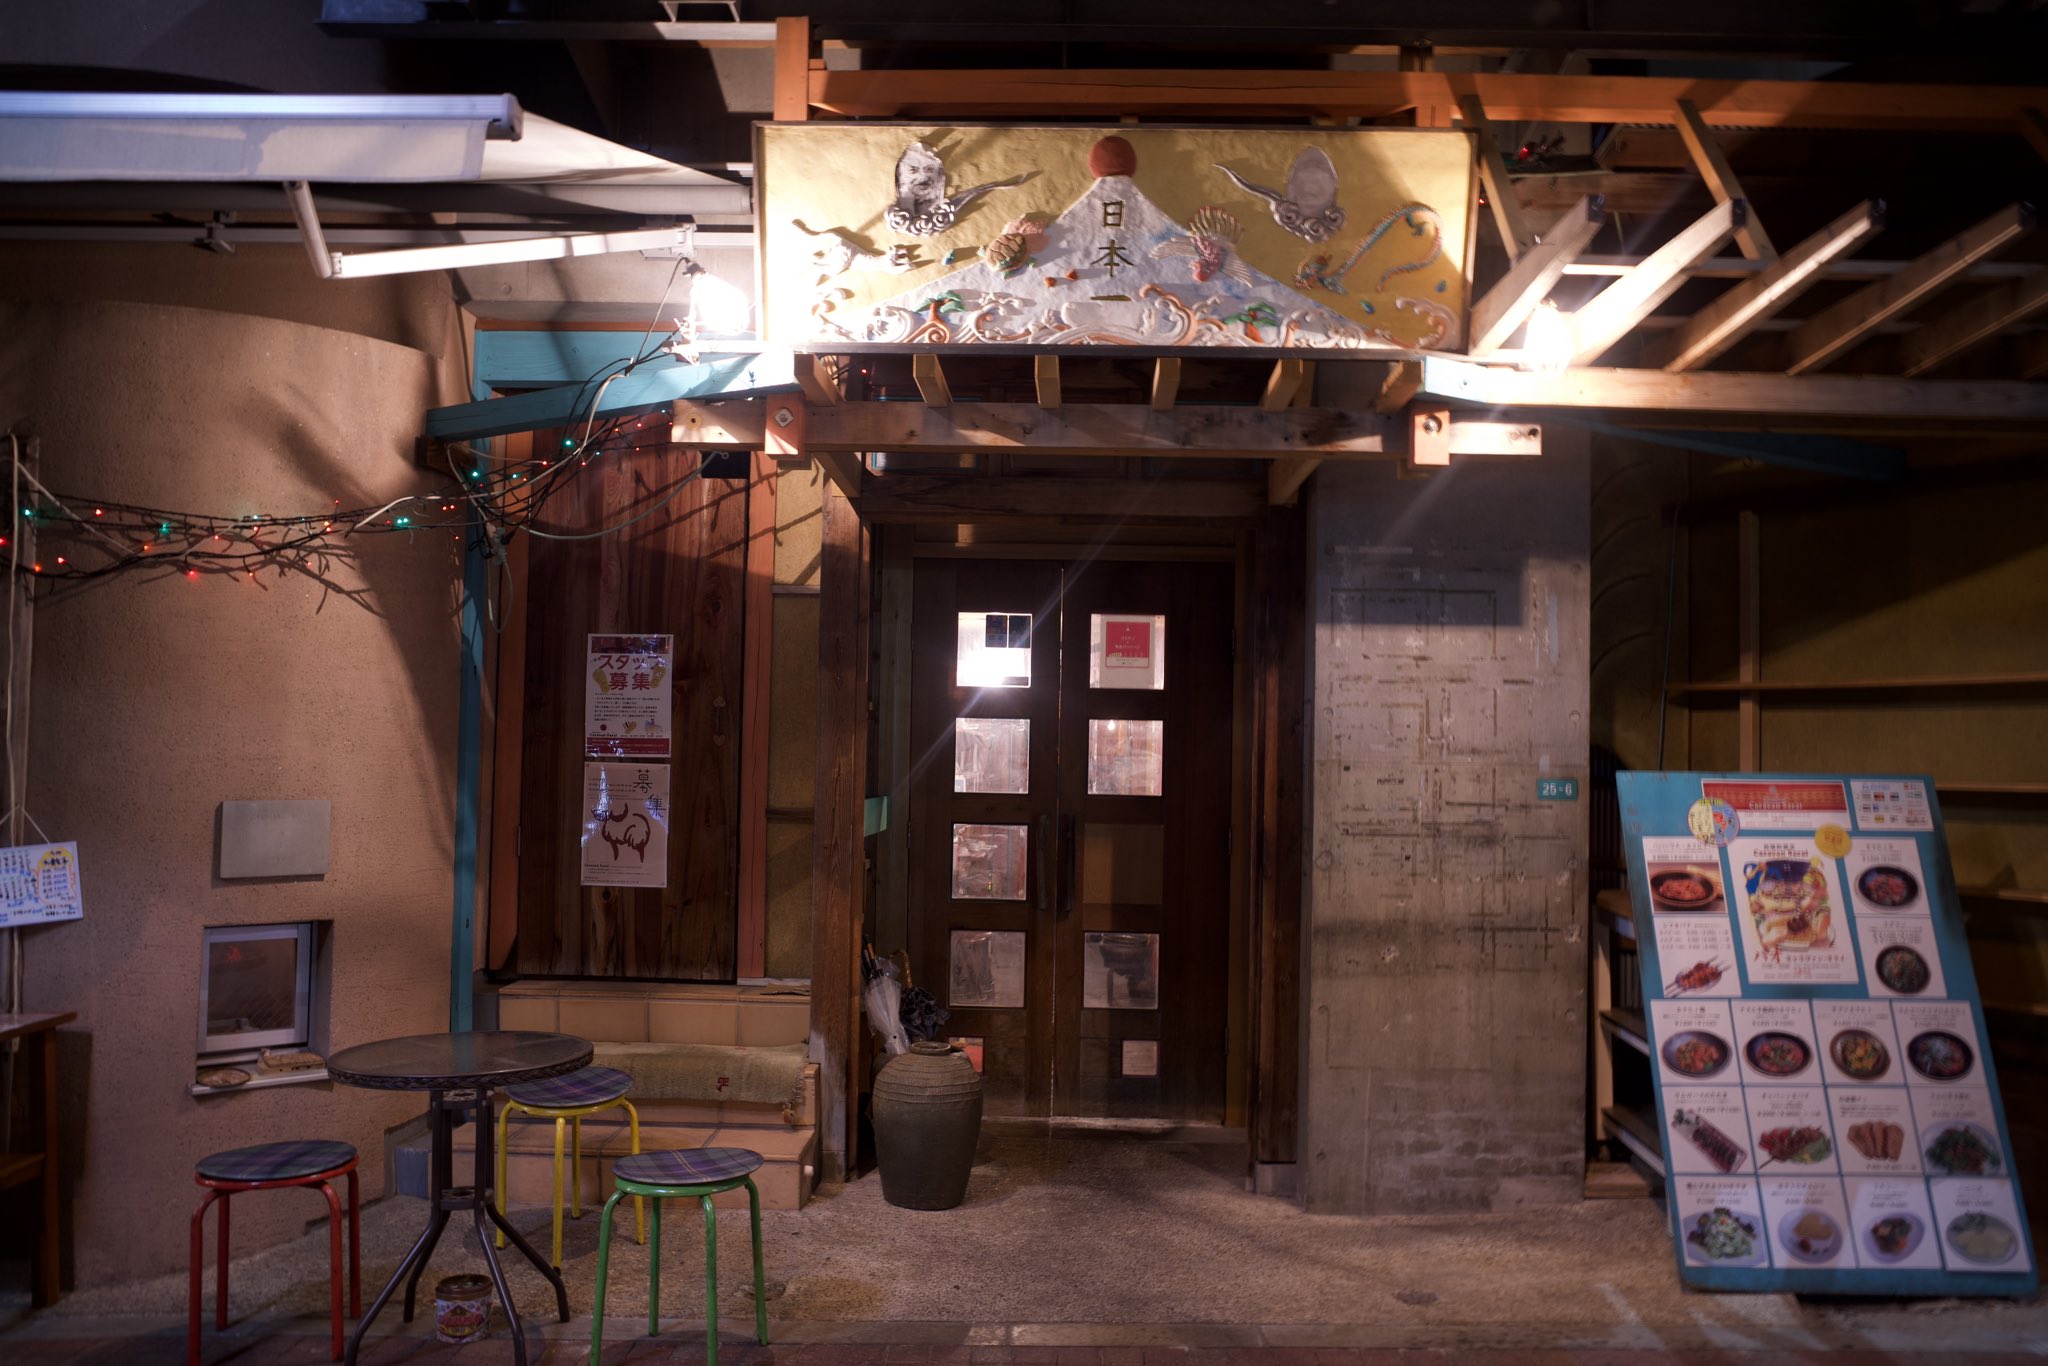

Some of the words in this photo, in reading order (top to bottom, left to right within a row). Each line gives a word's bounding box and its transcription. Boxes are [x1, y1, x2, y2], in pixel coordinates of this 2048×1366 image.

[1090, 200, 1135, 301] 日本一
[599, 655, 664, 670] スタッフ
[609, 672, 651, 690] 募集
[632, 768, 667, 818] 募集
